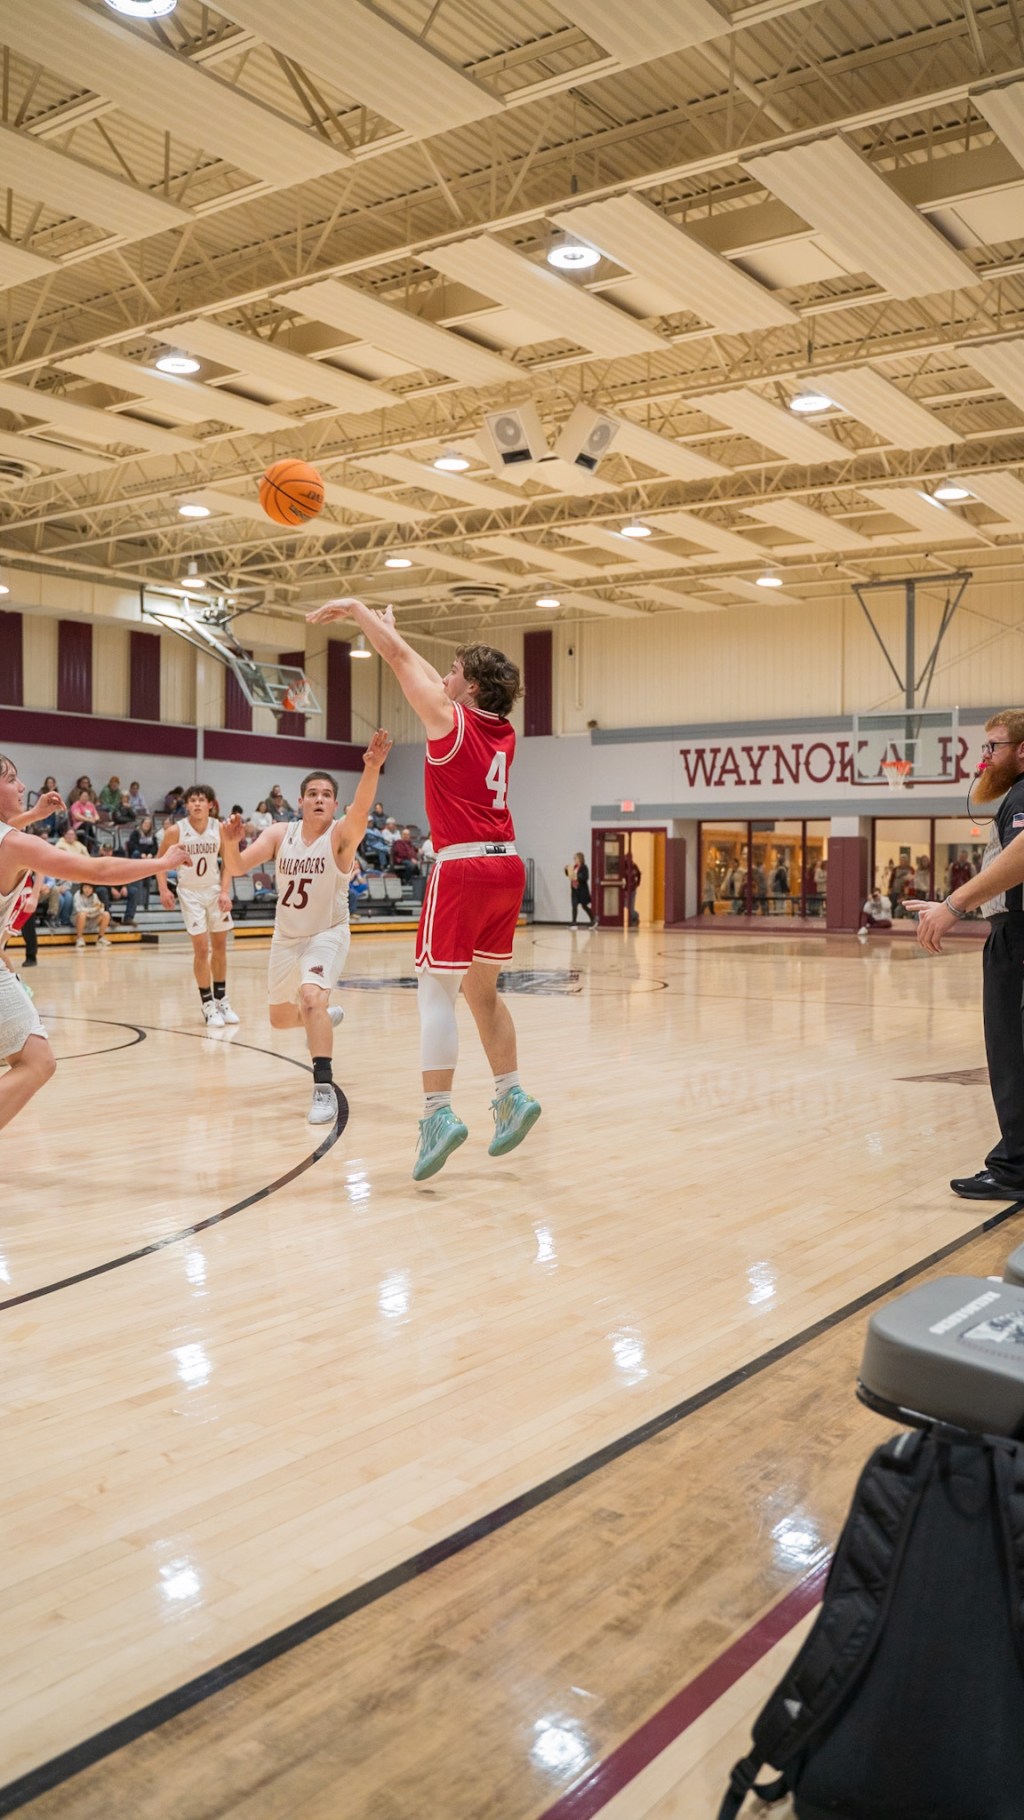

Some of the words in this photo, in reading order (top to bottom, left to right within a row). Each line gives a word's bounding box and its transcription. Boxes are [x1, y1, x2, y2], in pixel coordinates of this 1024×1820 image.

[485, 751, 507, 810] 4
[679, 738, 907, 787] WAYNOKA
[937, 736, 980, 778] R
[196, 857, 207, 877] 0
[281, 878, 313, 910] 25
